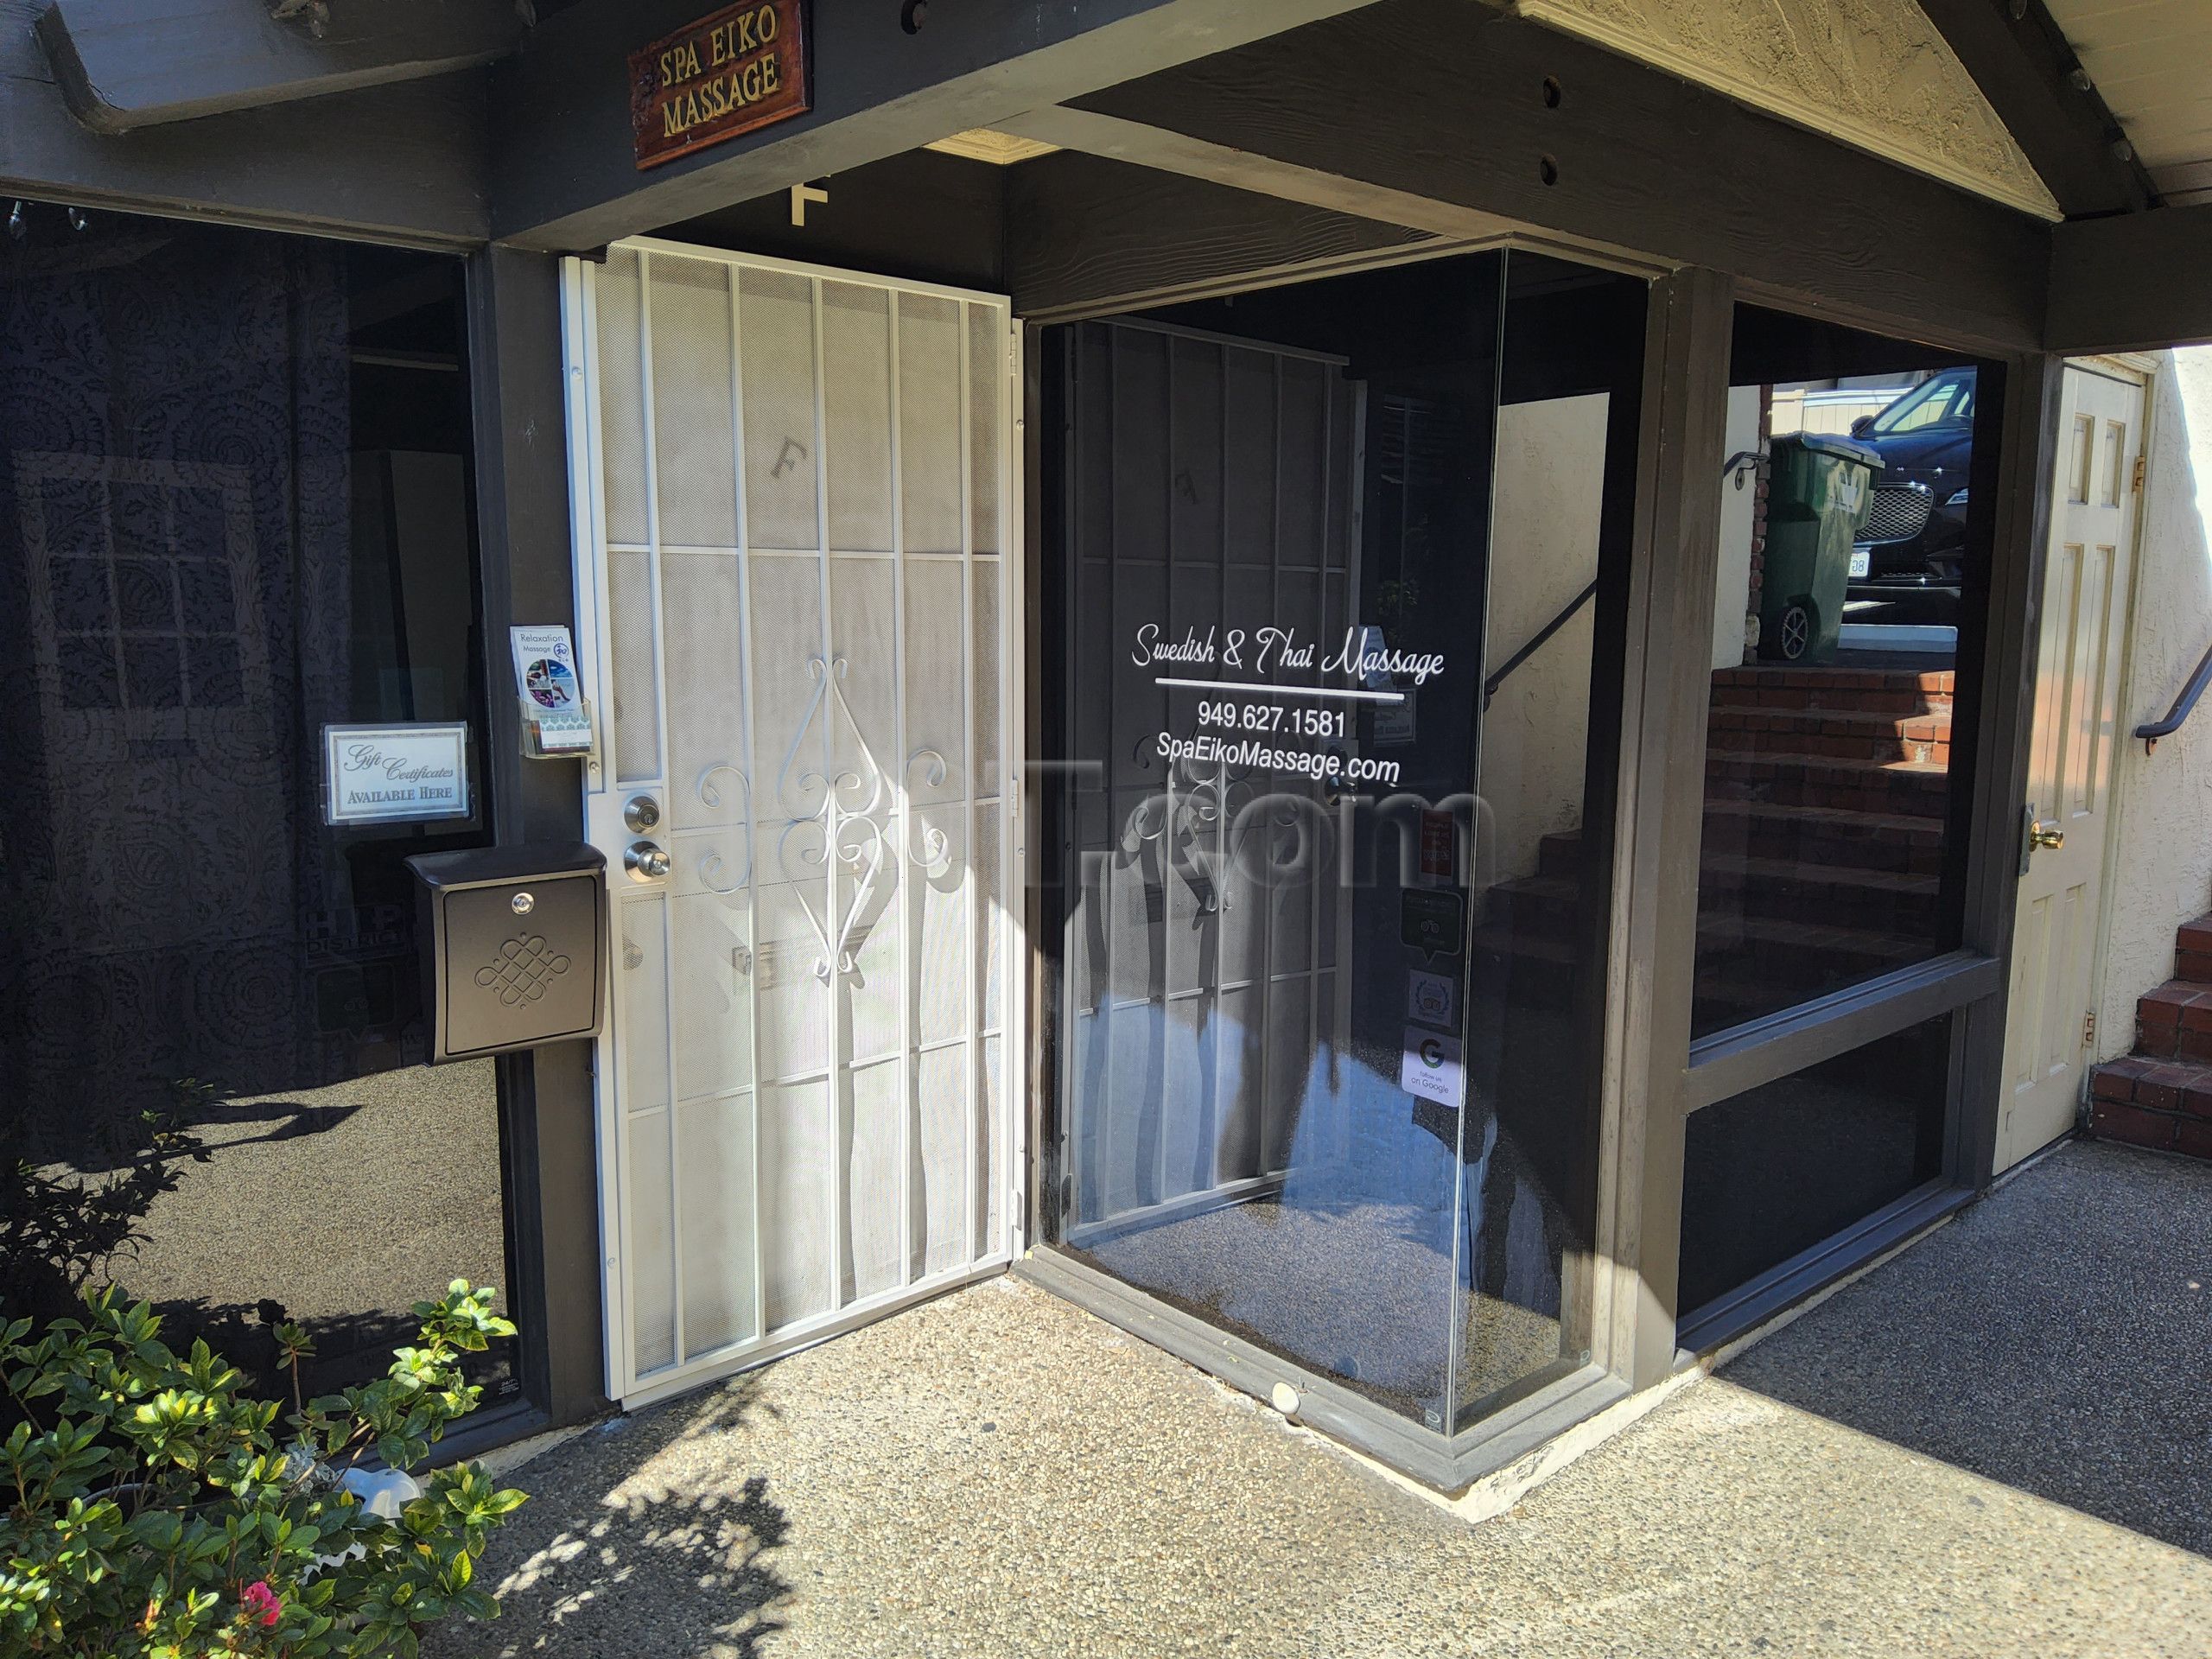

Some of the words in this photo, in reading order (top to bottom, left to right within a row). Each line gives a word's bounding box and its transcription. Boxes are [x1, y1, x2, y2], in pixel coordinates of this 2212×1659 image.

[660, 40, 702, 87] SPA
[709, 4, 777, 67] EIKO
[661, 51, 781, 138] MASSAGE
[520, 633, 563, 643] Relaxation
[1131, 622, 1216, 667] Swedish
[1223, 628, 1246, 670] &
[1255, 626, 1315, 674] Thai
[1320, 626, 1445, 685] Massage
[1198, 700, 1345, 738] 949.627.1581
[343, 744, 382, 772] Gift
[381, 757, 454, 784] Certificates
[1156, 731, 1401, 783] SpaEikoMassage.com
[346, 788, 416, 804] AVAILABLE
[419, 785, 453, 800] HERE
[1411, 1077, 1421, 1085] on
[1422, 1078, 1449, 1094] Google
